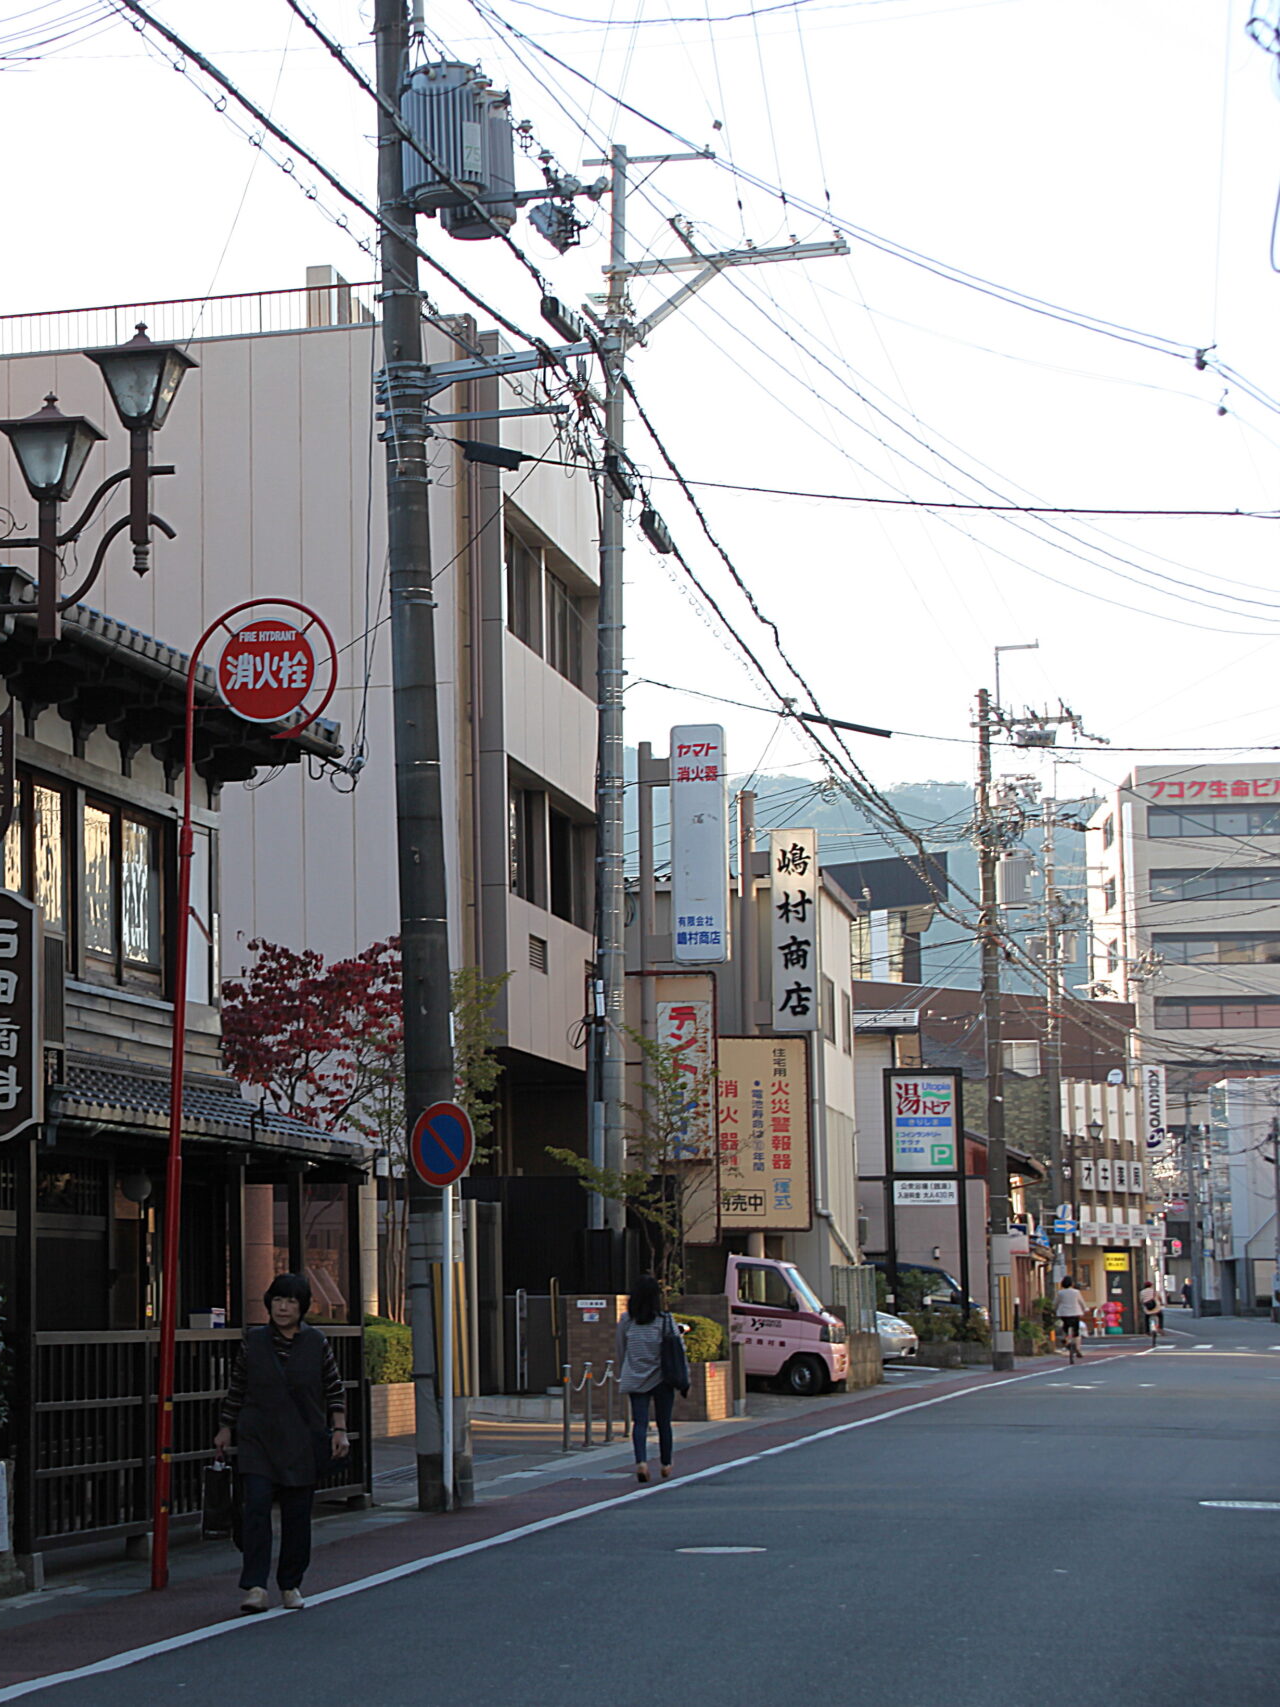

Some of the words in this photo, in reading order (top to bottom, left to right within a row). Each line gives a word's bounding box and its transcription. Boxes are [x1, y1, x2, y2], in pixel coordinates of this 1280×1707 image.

[239, 632, 257, 642] FIRE
[259, 631, 297, 641] HYDRANT
[225, 651, 308, 690] 消火栓
[677, 743, 718, 757] ヤマト
[677, 765, 718, 782] 消火器
[678, 916, 714, 927] 有限会社
[776, 843, 814, 1017] 嶋村商店
[718, 1080, 738, 1151] 消火器
[1148, 1069, 1161, 1128] KOKUYO
[771, 1080, 792, 1170] 火災警報器
